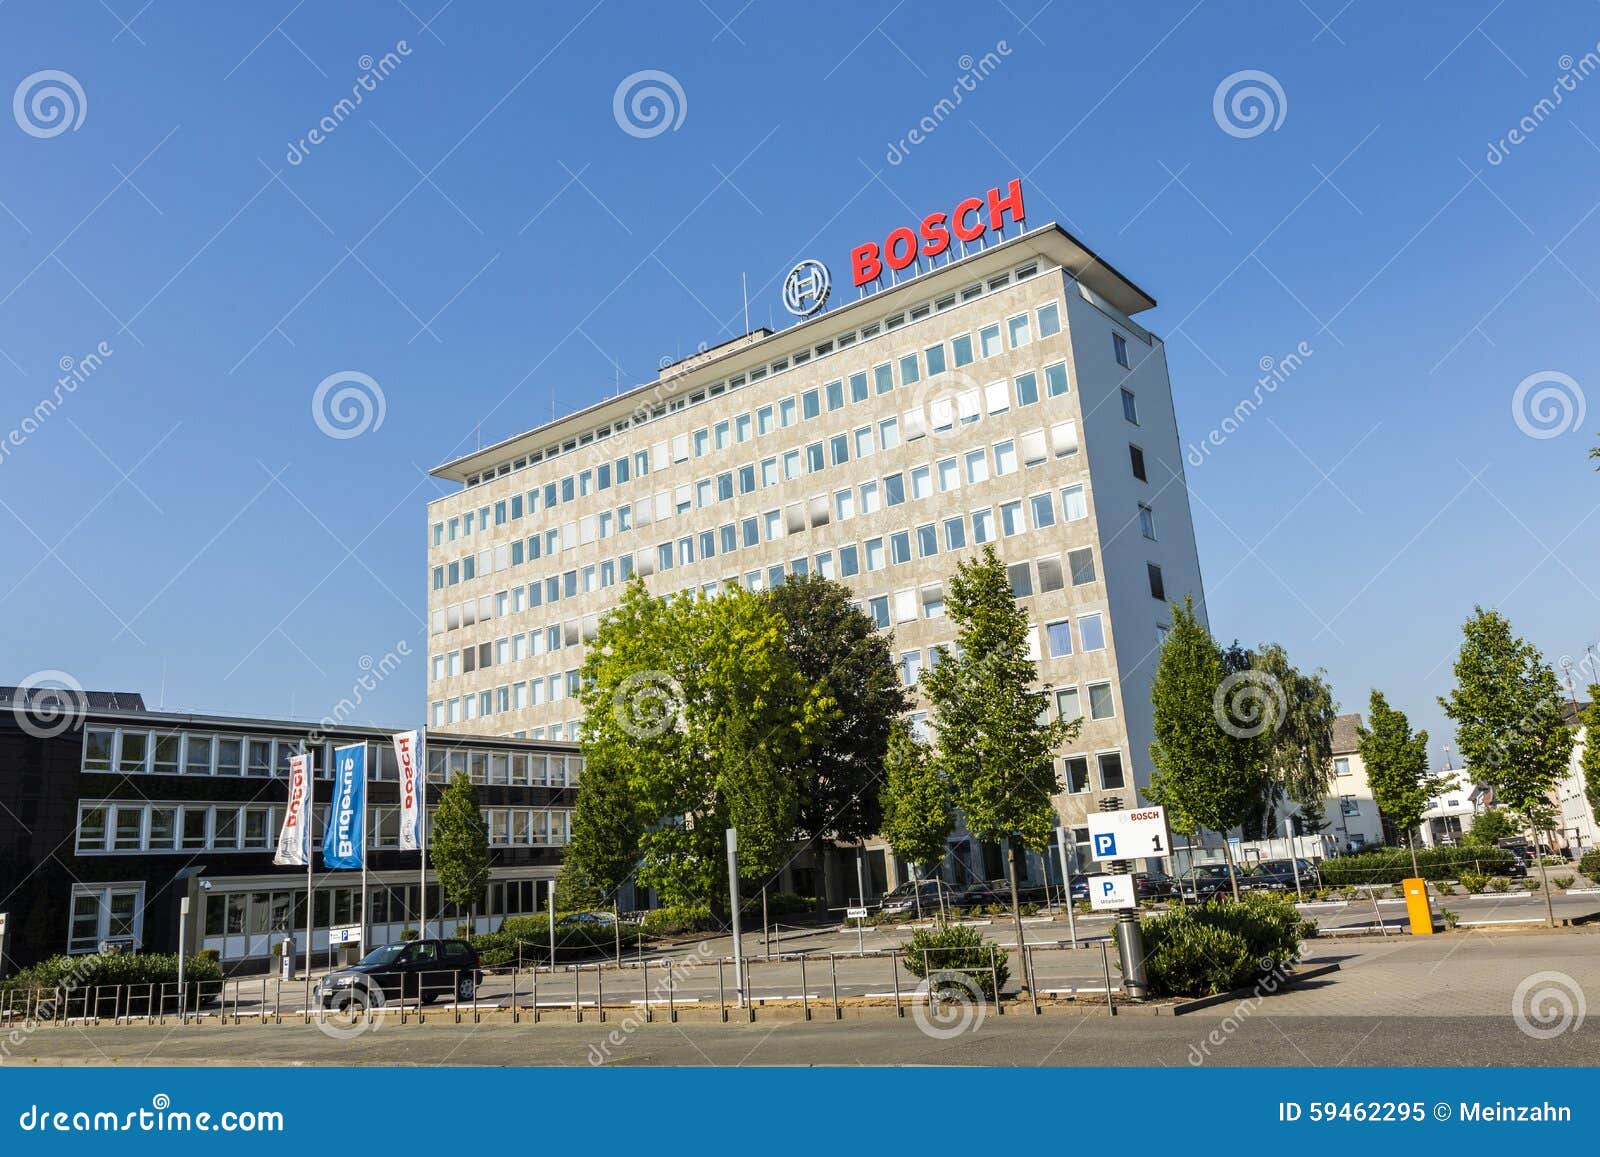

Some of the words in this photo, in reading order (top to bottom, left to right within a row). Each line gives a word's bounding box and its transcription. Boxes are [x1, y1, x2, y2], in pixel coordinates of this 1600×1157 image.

[851, 178, 1026, 287] BOSCH
[1131, 811, 1160, 821] BOSCH
[1098, 836, 1112, 853] P
[1152, 834, 1163, 852] 1
[1103, 882, 1114, 896] P
